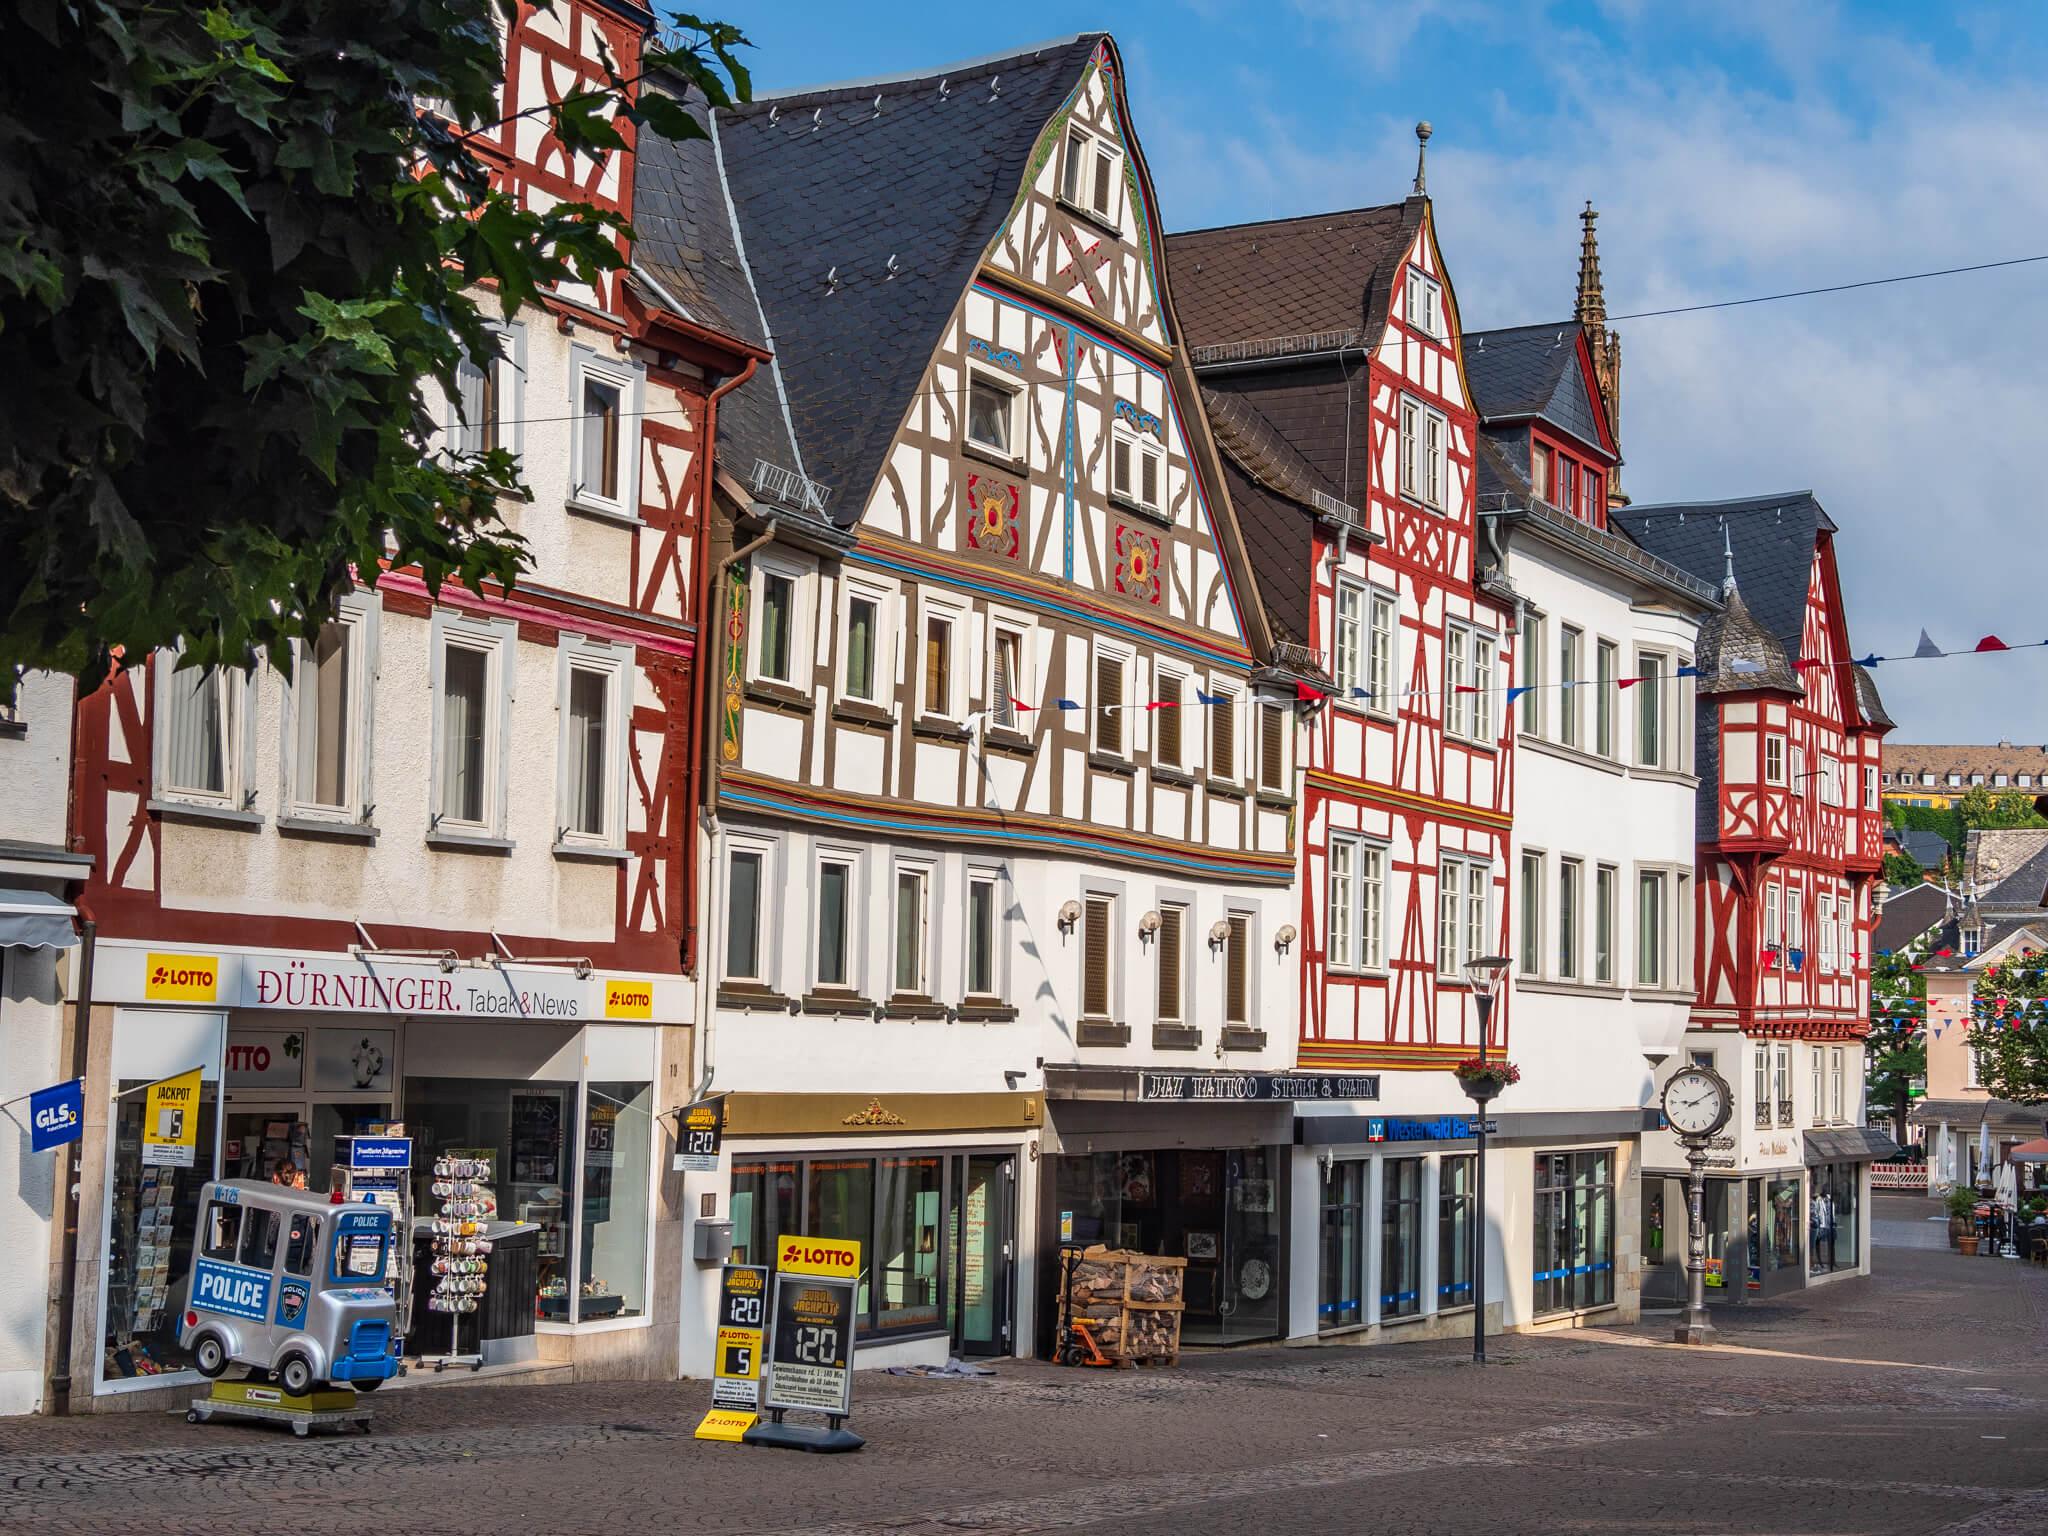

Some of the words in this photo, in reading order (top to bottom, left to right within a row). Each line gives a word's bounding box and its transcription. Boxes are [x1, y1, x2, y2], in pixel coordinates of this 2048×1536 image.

[170, 969, 213, 987] LOTTO
[621, 994, 649, 1006] LOTTO
[225, 1046, 271, 1071] TTO
[670, 1063, 678, 1079] 10
[157, 1086, 191, 1101] JACKPOT
[1148, 1075, 1185, 1098] JAZ
[1191, 1076, 1258, 1098] TATTOO
[1271, 1077, 1317, 1098] STYLE
[1322, 1078, 1332, 1098] &
[36, 1103, 70, 1128] GLS
[172, 1110, 182, 1138] 5
[1387, 1115, 1451, 1140] Westerwald
[689, 1131, 714, 1153] 120
[1029, 1140, 1040, 1162] 8
[353, 1216, 379, 1227] POLICE
[804, 1247, 855, 1267] LOTTO
[199, 1273, 264, 1308] POLICE
[283, 1286, 306, 1298] POLICE
[731, 1297, 760, 1323] 120
[728, 1330, 749, 1340] LOTTO
[795, 1327, 838, 1364] 120
[737, 1349, 749, 1375] 5
[718, 1419, 747, 1427] LOTTO
